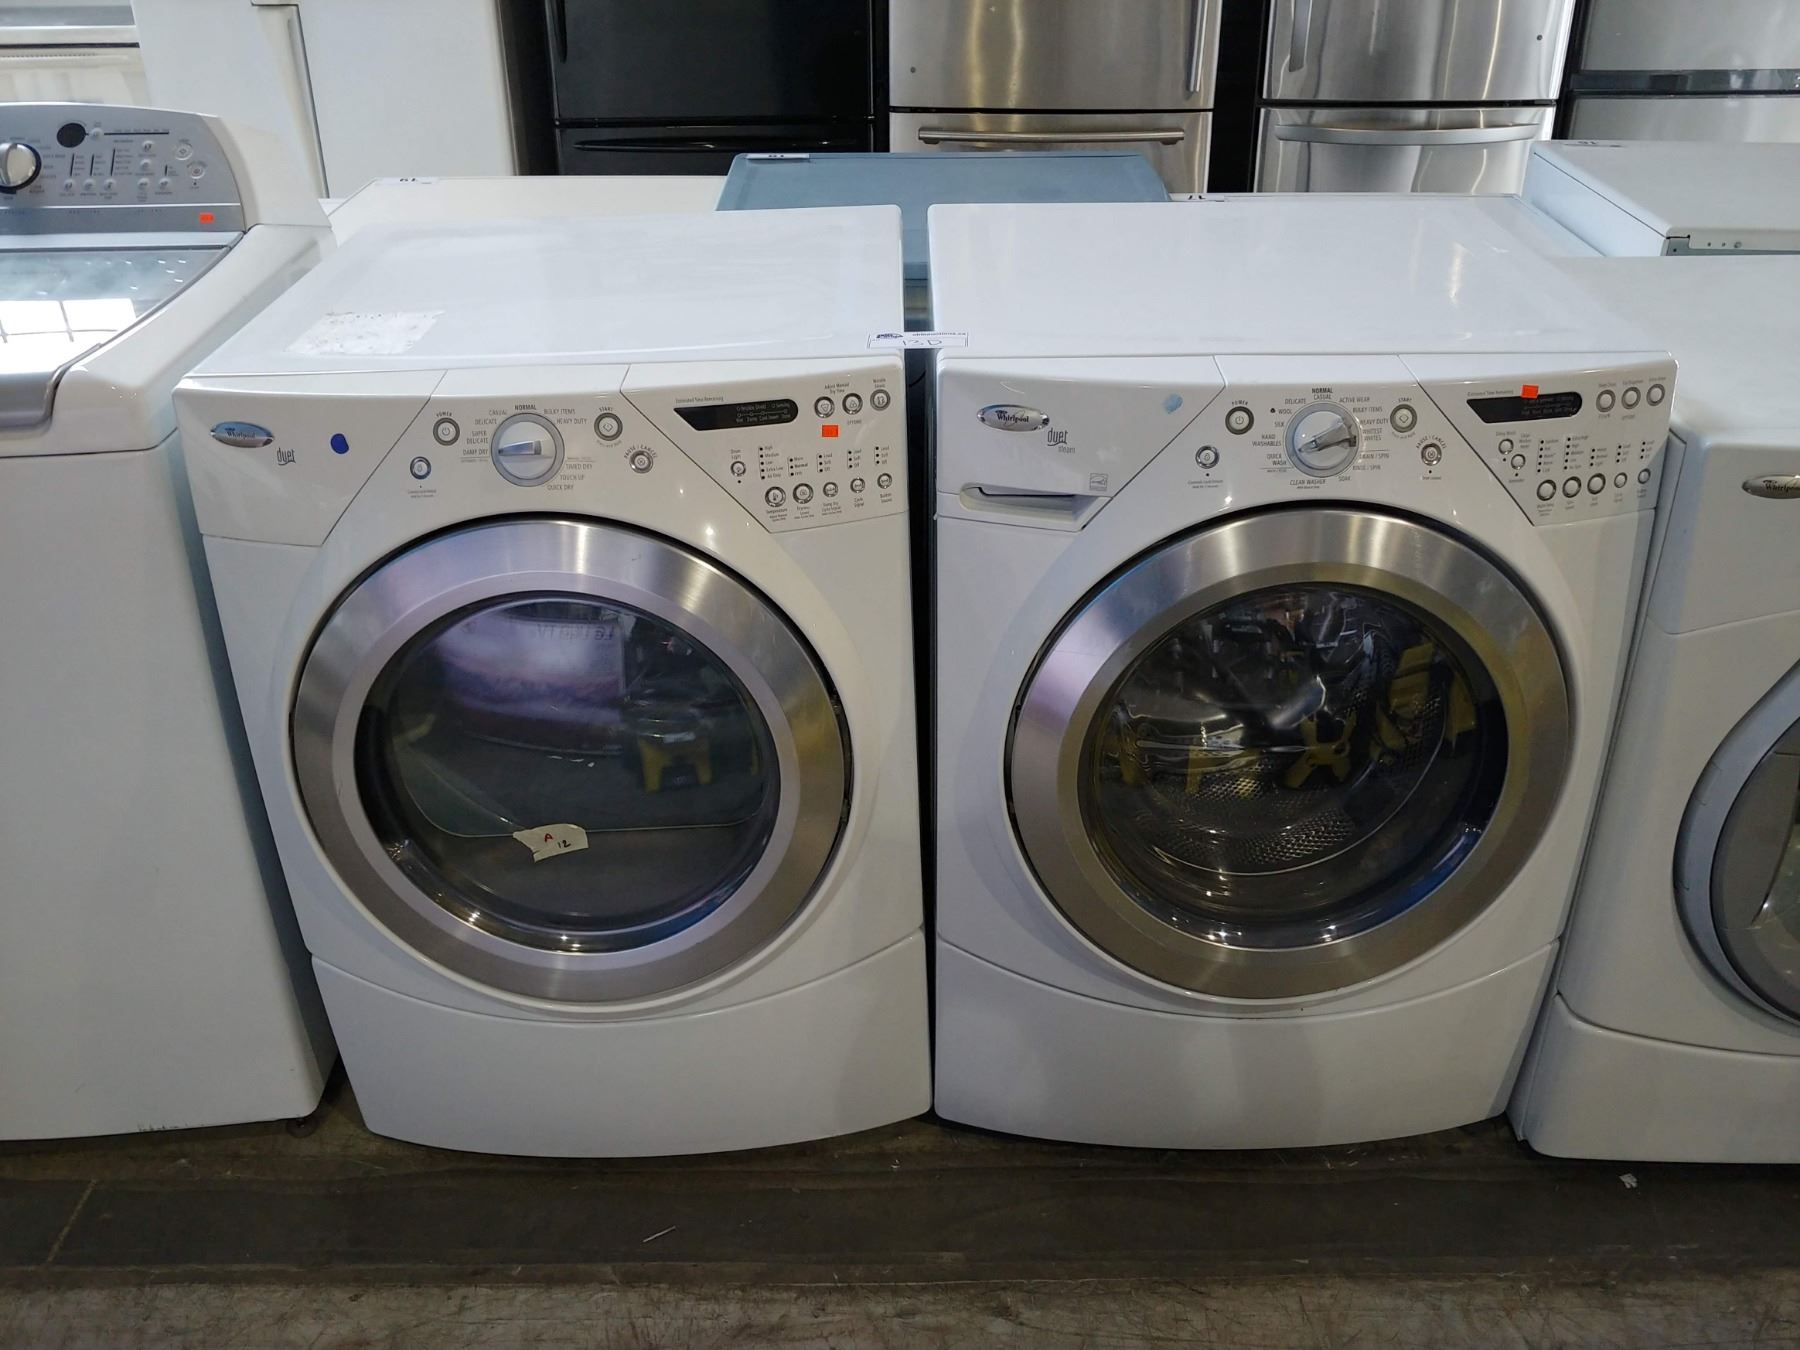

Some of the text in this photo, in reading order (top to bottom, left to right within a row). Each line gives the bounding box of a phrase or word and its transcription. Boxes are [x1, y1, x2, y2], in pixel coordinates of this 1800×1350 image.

[474, 418, 498, 426] DELICATE
[996, 413, 1029, 423] Whirlpool
[226, 431, 256, 440] Whirlpool
[1047, 428, 1068, 445] duet
[276, 447, 296, 464] duet
[478, 448, 488, 456] DRY
[544, 833, 553, 843] A
[557, 840, 571, 848] 12
